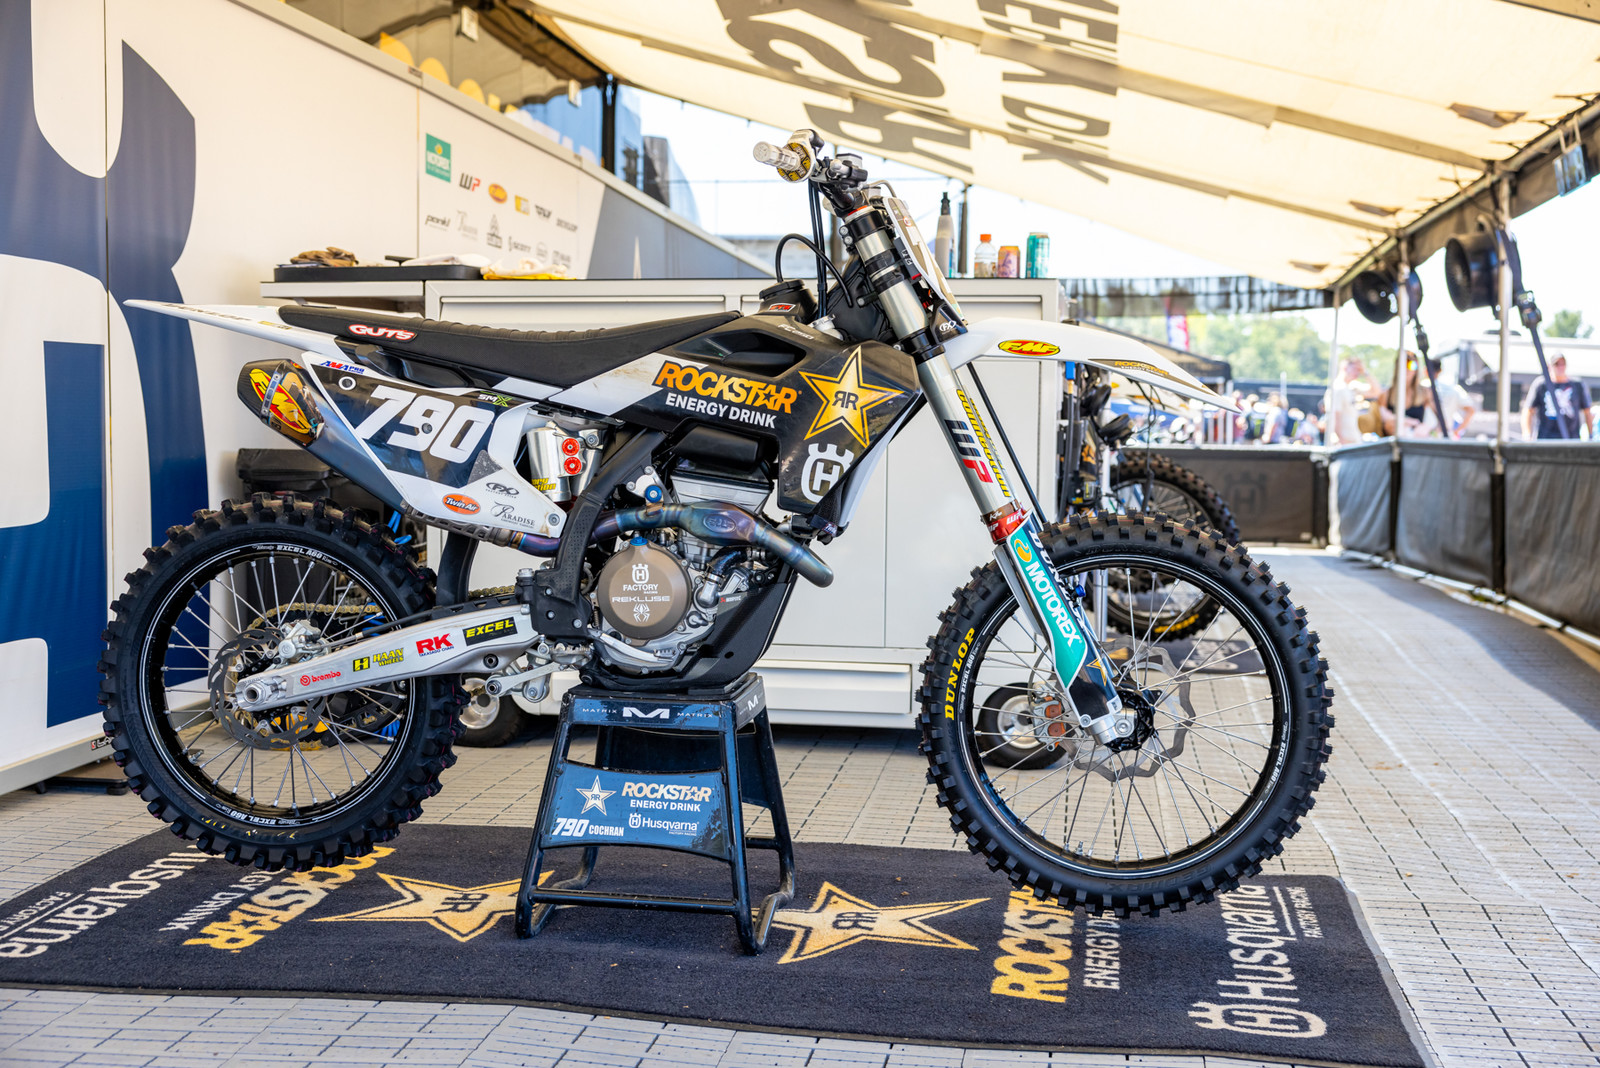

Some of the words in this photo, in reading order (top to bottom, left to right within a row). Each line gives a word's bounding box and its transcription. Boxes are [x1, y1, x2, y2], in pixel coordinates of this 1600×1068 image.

[349, 324, 415, 341] GUTS
[998, 340, 1060, 355] FMF
[320, 360, 349, 371] AMA
[653, 360, 798, 414] ROCKSTAR
[478, 390, 512, 407] SMX
[666, 393, 728, 418] ENERGY
[729, 410, 777, 429] DRINK
[354, 384, 495, 464] 790
[944, 419, 993, 483] WP
[445, 497, 464, 508] Twin
[464, 502, 479, 513] Air
[623, 584, 658, 592] FACTORY
[1025, 560, 1082, 648] MOTOREX
[466, 620, 514, 638] EXCEL
[416, 633, 453, 654] RK
[373, 648, 404, 662] HAAN
[378, 656, 404, 667] WHEELS
[312, 671, 341, 683] brembo
[944, 627, 975, 721] DUNLOP
[622, 782, 712, 802] ROCKSTAR
[630, 800, 668, 810] ENERGY
[670, 801, 701, 812] DRINK
[552, 818, 589, 837] 790
[589, 825, 624, 837] COCHRAN
[642, 817, 697, 830] Husqvarna
[1083, 929, 1120, 990] ENERGY
